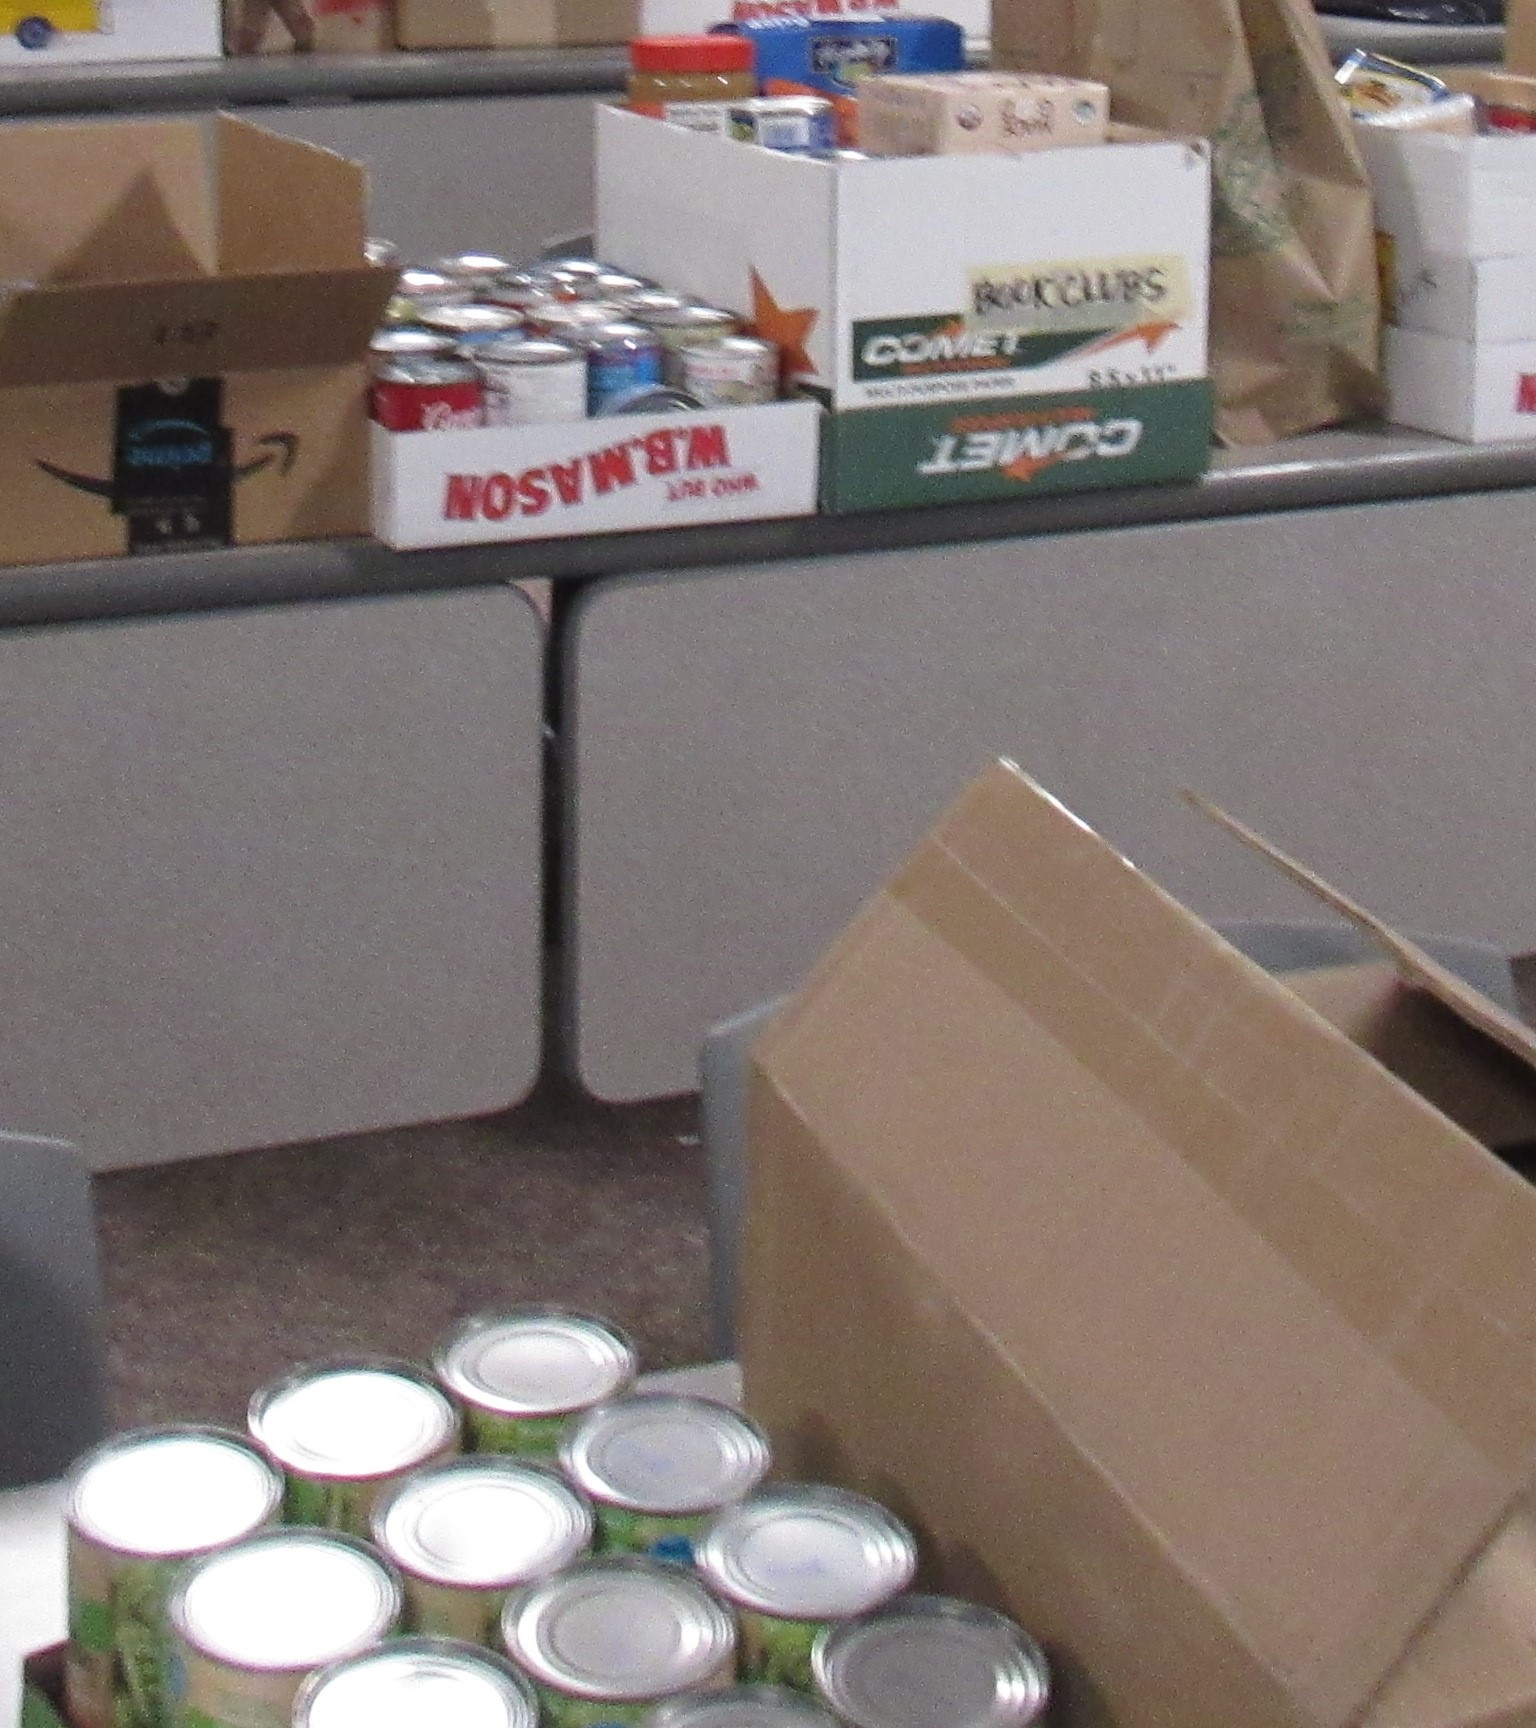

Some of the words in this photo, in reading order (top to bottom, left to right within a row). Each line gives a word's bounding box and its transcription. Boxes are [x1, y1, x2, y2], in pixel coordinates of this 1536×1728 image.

[861, 331, 1021, 367] COMET
[442, 424, 730, 522] W.B.MASON
[917, 416, 1143, 475] COMET
